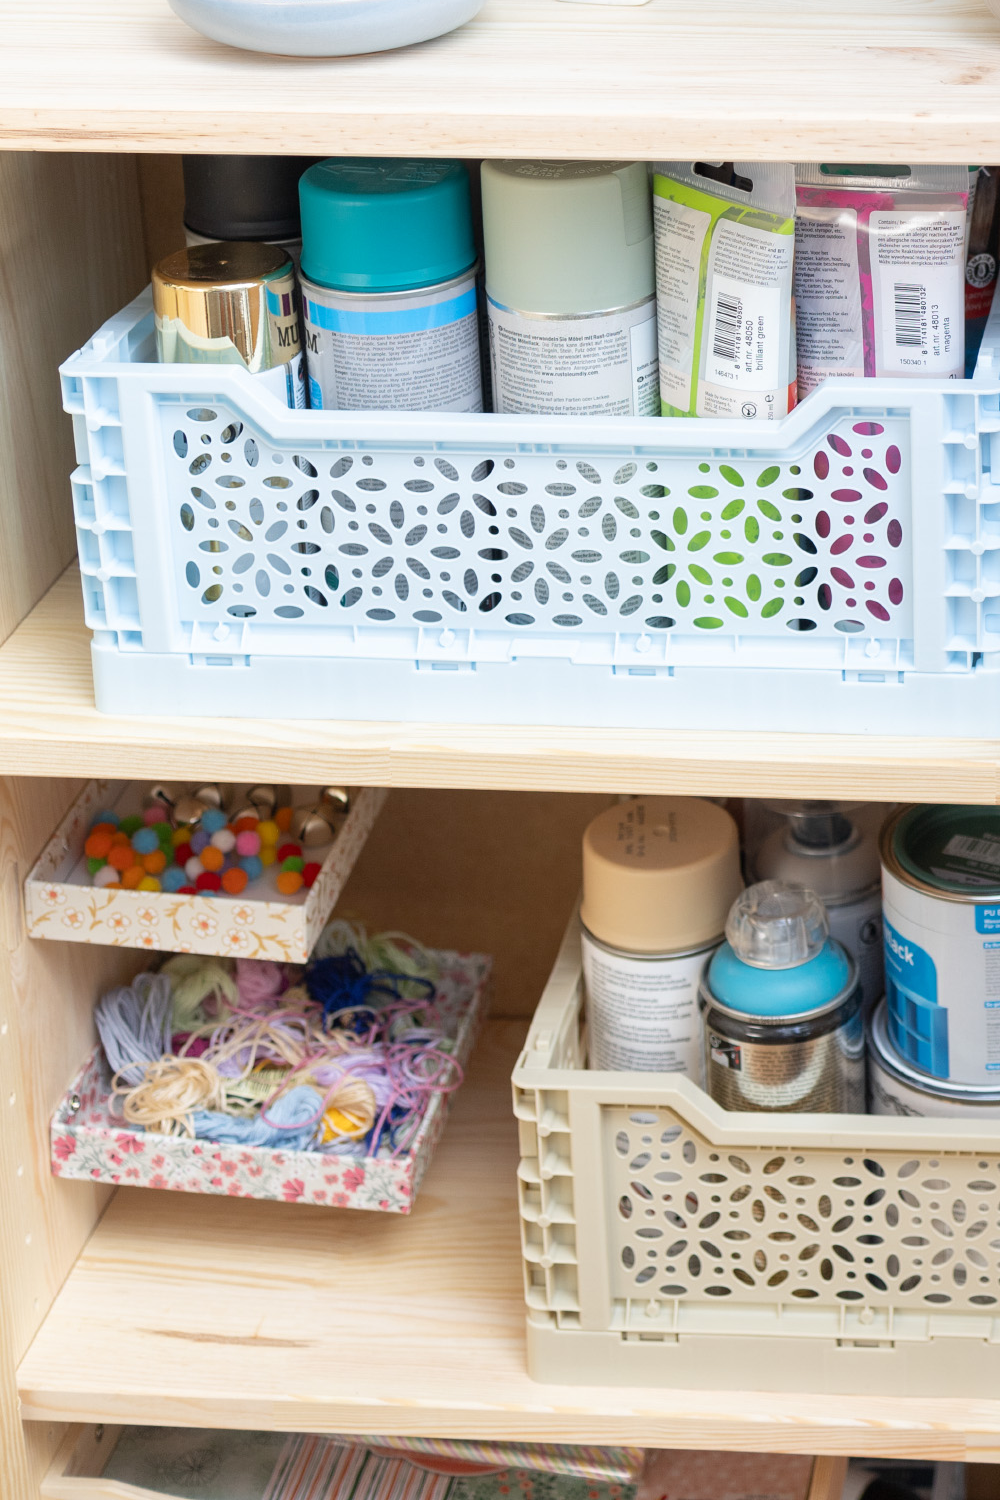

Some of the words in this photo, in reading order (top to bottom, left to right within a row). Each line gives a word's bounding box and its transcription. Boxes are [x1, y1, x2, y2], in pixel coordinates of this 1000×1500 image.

[757, 316, 765, 339] green
[715, 369, 734, 379] 146473
[983, 909, 996, 917] PU
